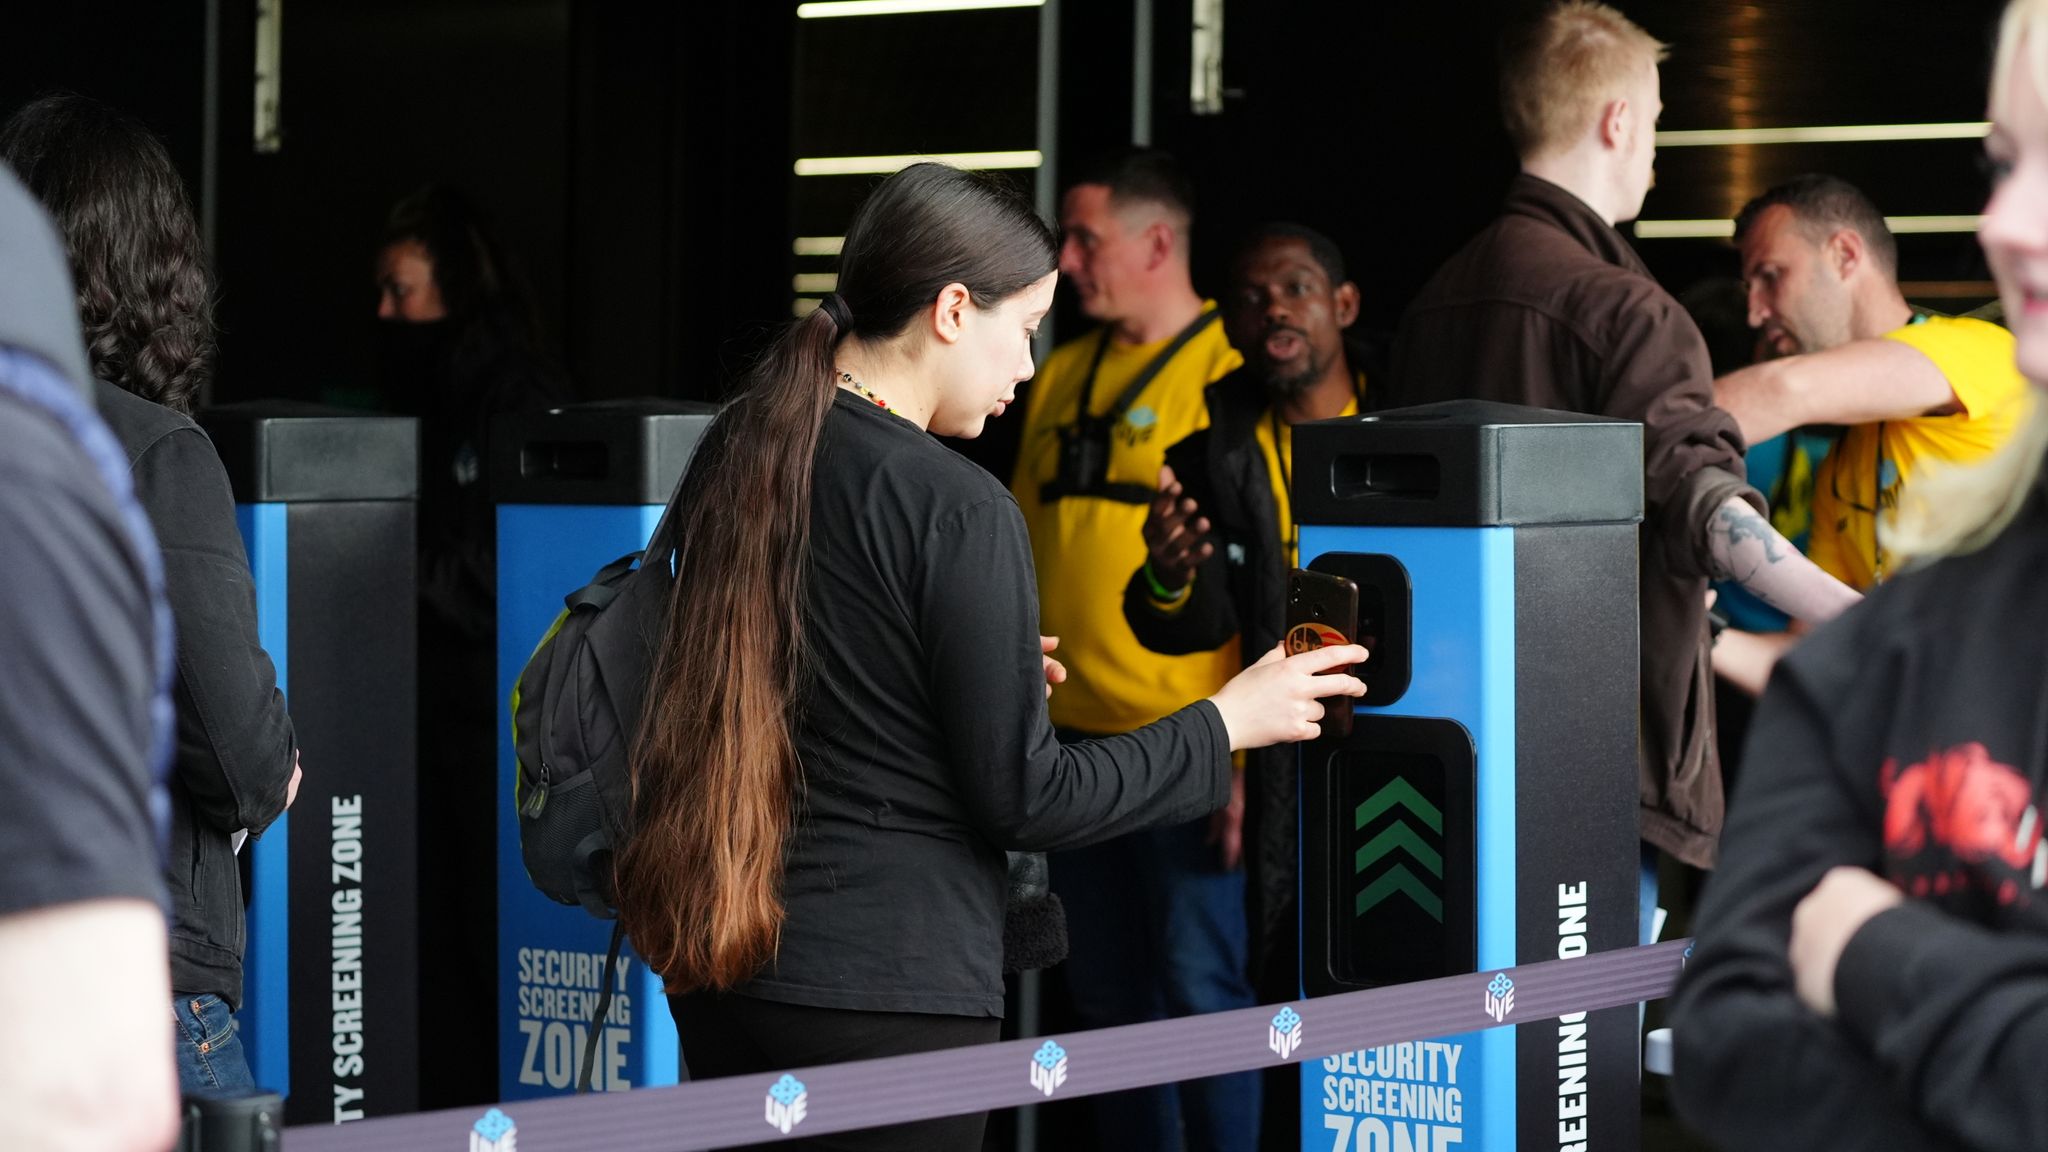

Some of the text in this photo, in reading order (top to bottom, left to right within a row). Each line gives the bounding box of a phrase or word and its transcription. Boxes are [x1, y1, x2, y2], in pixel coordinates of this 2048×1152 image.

[332, 794, 363, 884] ZONE
[1558, 881, 1587, 960] ONE
[332, 887, 364, 1078] SCREENING
[519, 1019, 631, 1091] ZONE
[1323, 1075, 1462, 1123] SCREENING
